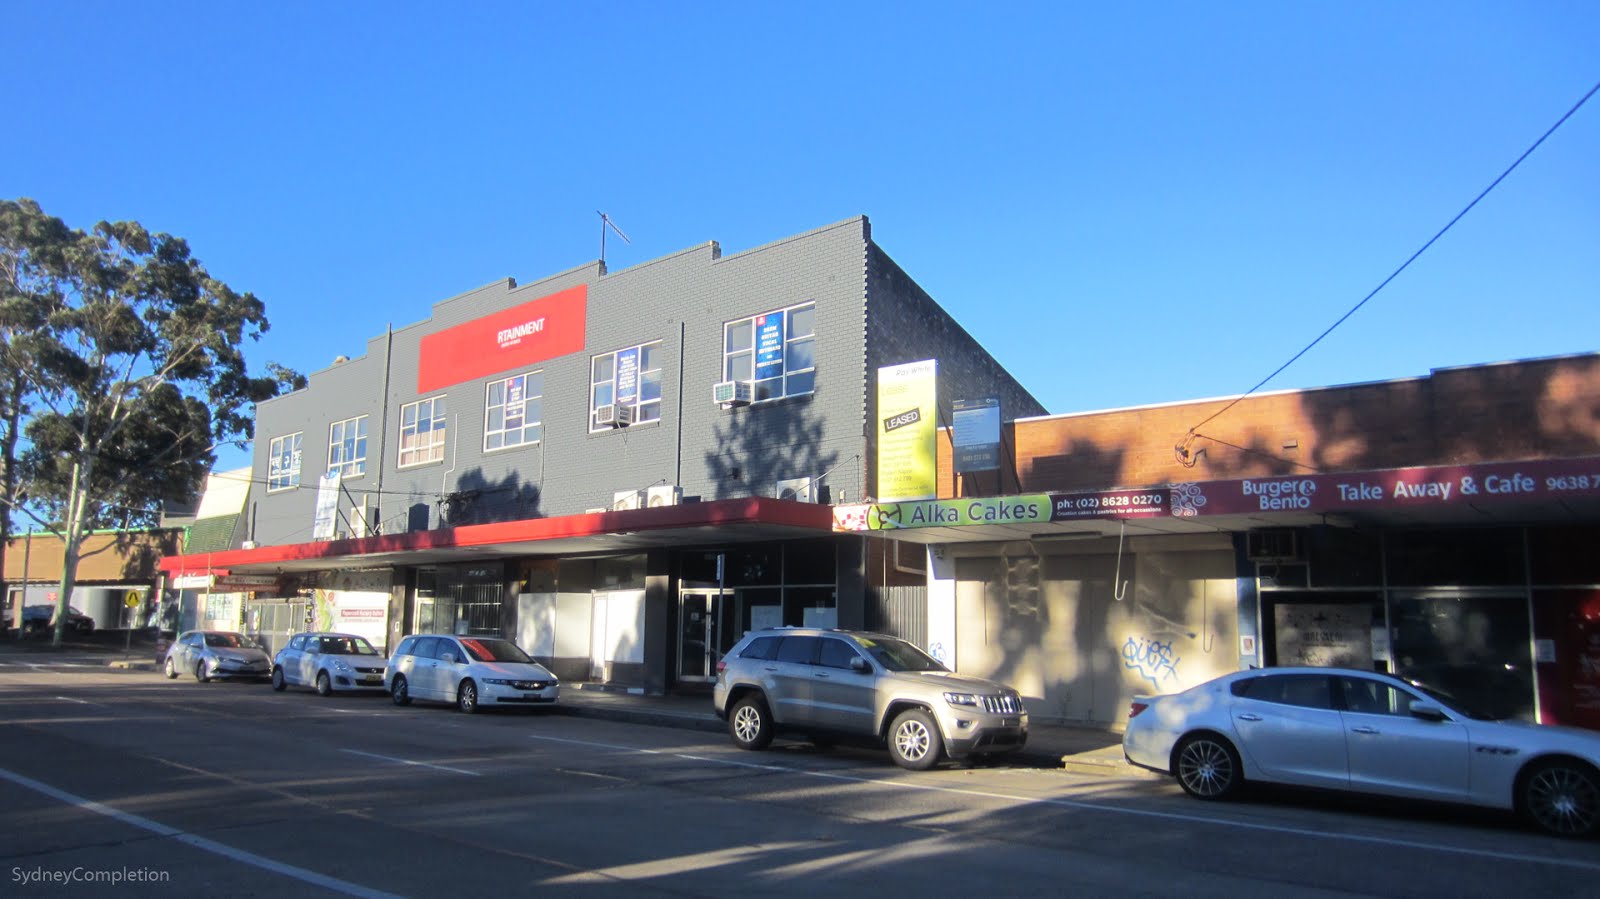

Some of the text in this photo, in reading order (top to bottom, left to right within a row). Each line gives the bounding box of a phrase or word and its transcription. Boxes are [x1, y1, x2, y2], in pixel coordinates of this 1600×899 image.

[497, 318, 545, 344] RTAINMENT
[886, 411, 917, 428] LEASED
[1337, 482, 1383, 501] Take
[1393, 480, 1452, 500] Away
[1460, 476, 1478, 495] &
[1485, 473, 1535, 493] Cafe
[1545, 475, 1590, 491] 9638
[911, 500, 1038, 524] Alka Cakes
[1057, 495, 1162, 510] ph: (02) 8628 0270
[1259, 494, 1311, 510] Bento
